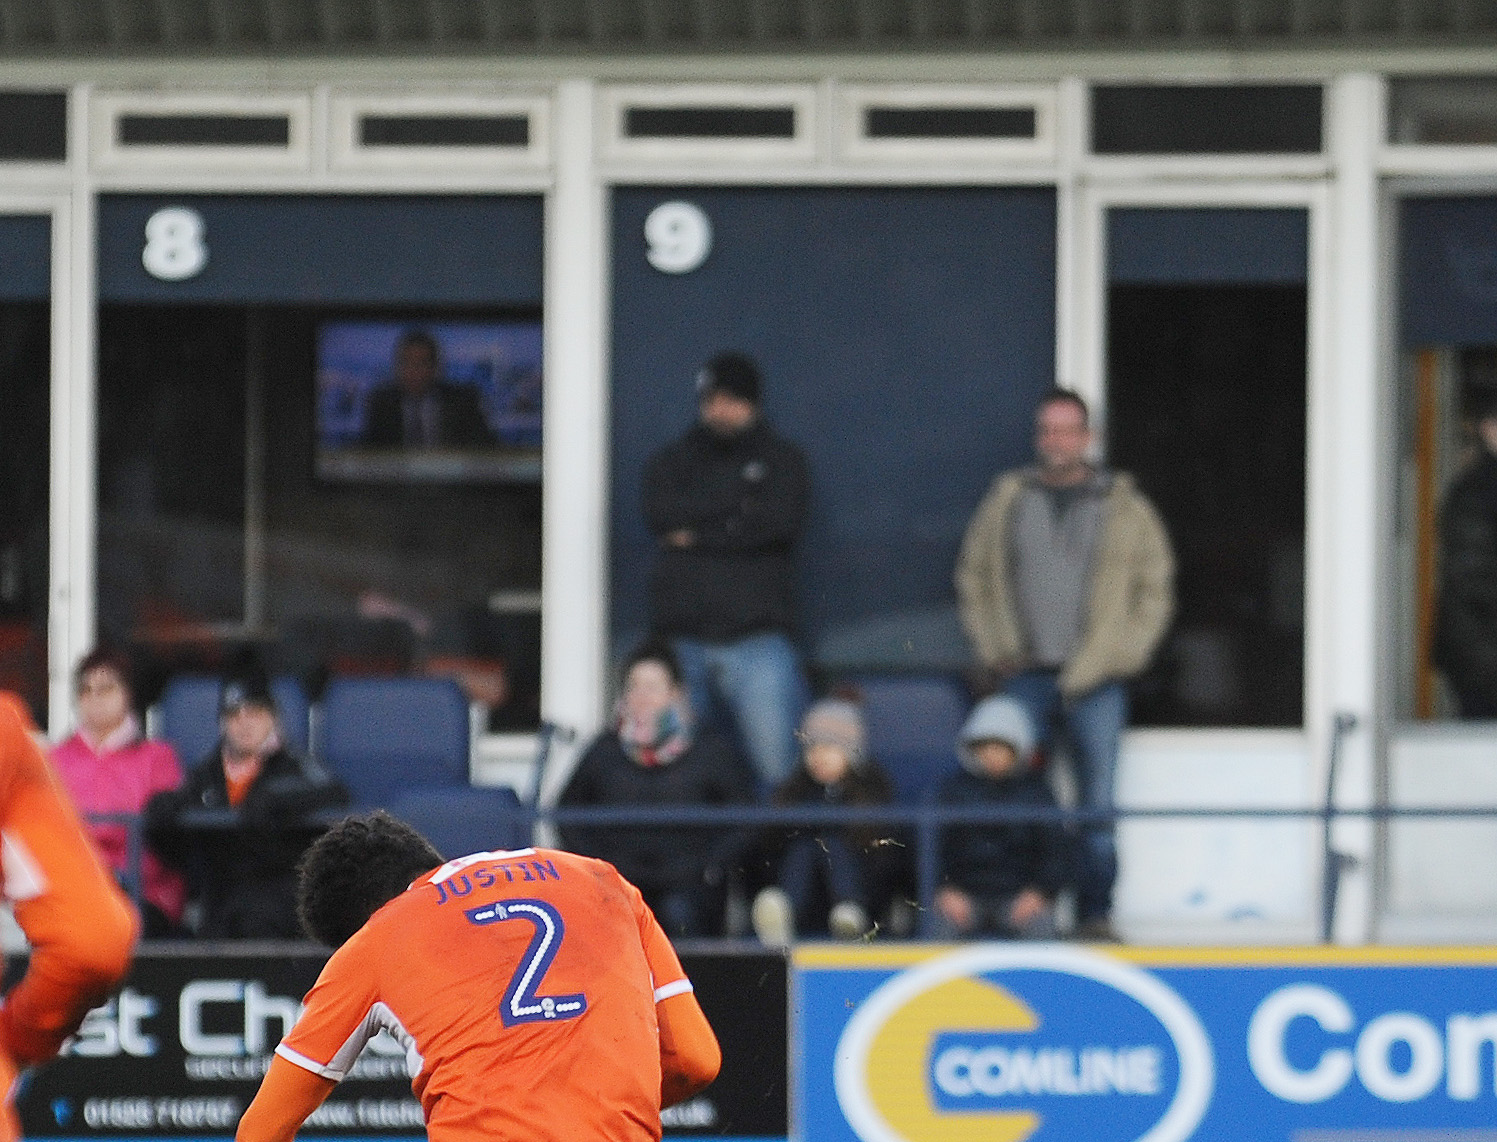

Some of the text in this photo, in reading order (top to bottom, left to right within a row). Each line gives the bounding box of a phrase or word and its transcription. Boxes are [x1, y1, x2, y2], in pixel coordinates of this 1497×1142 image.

[141, 206, 208, 280] 8
[644, 201, 712, 274] 9
[434, 859, 560, 906] JUSTIN
[463, 898, 588, 1030] 2
[934, 1045, 1160, 1097] COMLINE
